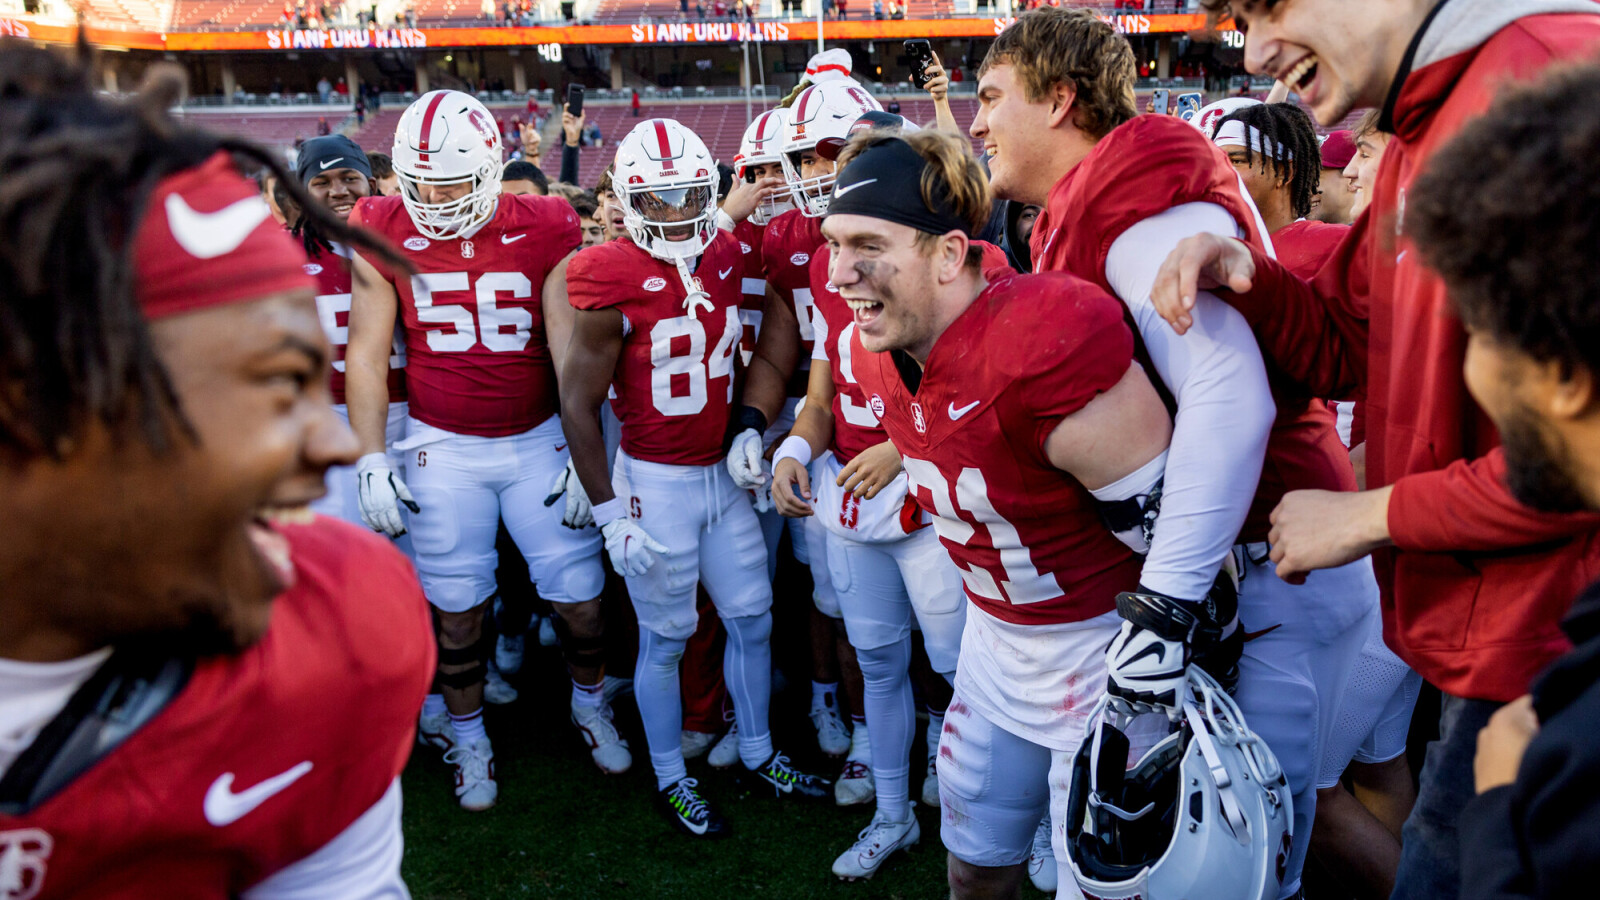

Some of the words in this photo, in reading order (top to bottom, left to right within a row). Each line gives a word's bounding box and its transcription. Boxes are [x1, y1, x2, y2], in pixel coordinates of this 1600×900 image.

[267, 29, 370, 49] STANFORD
[631, 22, 733, 41] STANFORD
[1222, 30, 1245, 48] 40
[537, 42, 562, 62] 40
[646, 279, 664, 288] ACC
[410, 271, 532, 352] 56
[650, 304, 743, 416] 84
[902, 453, 1065, 605] 21
